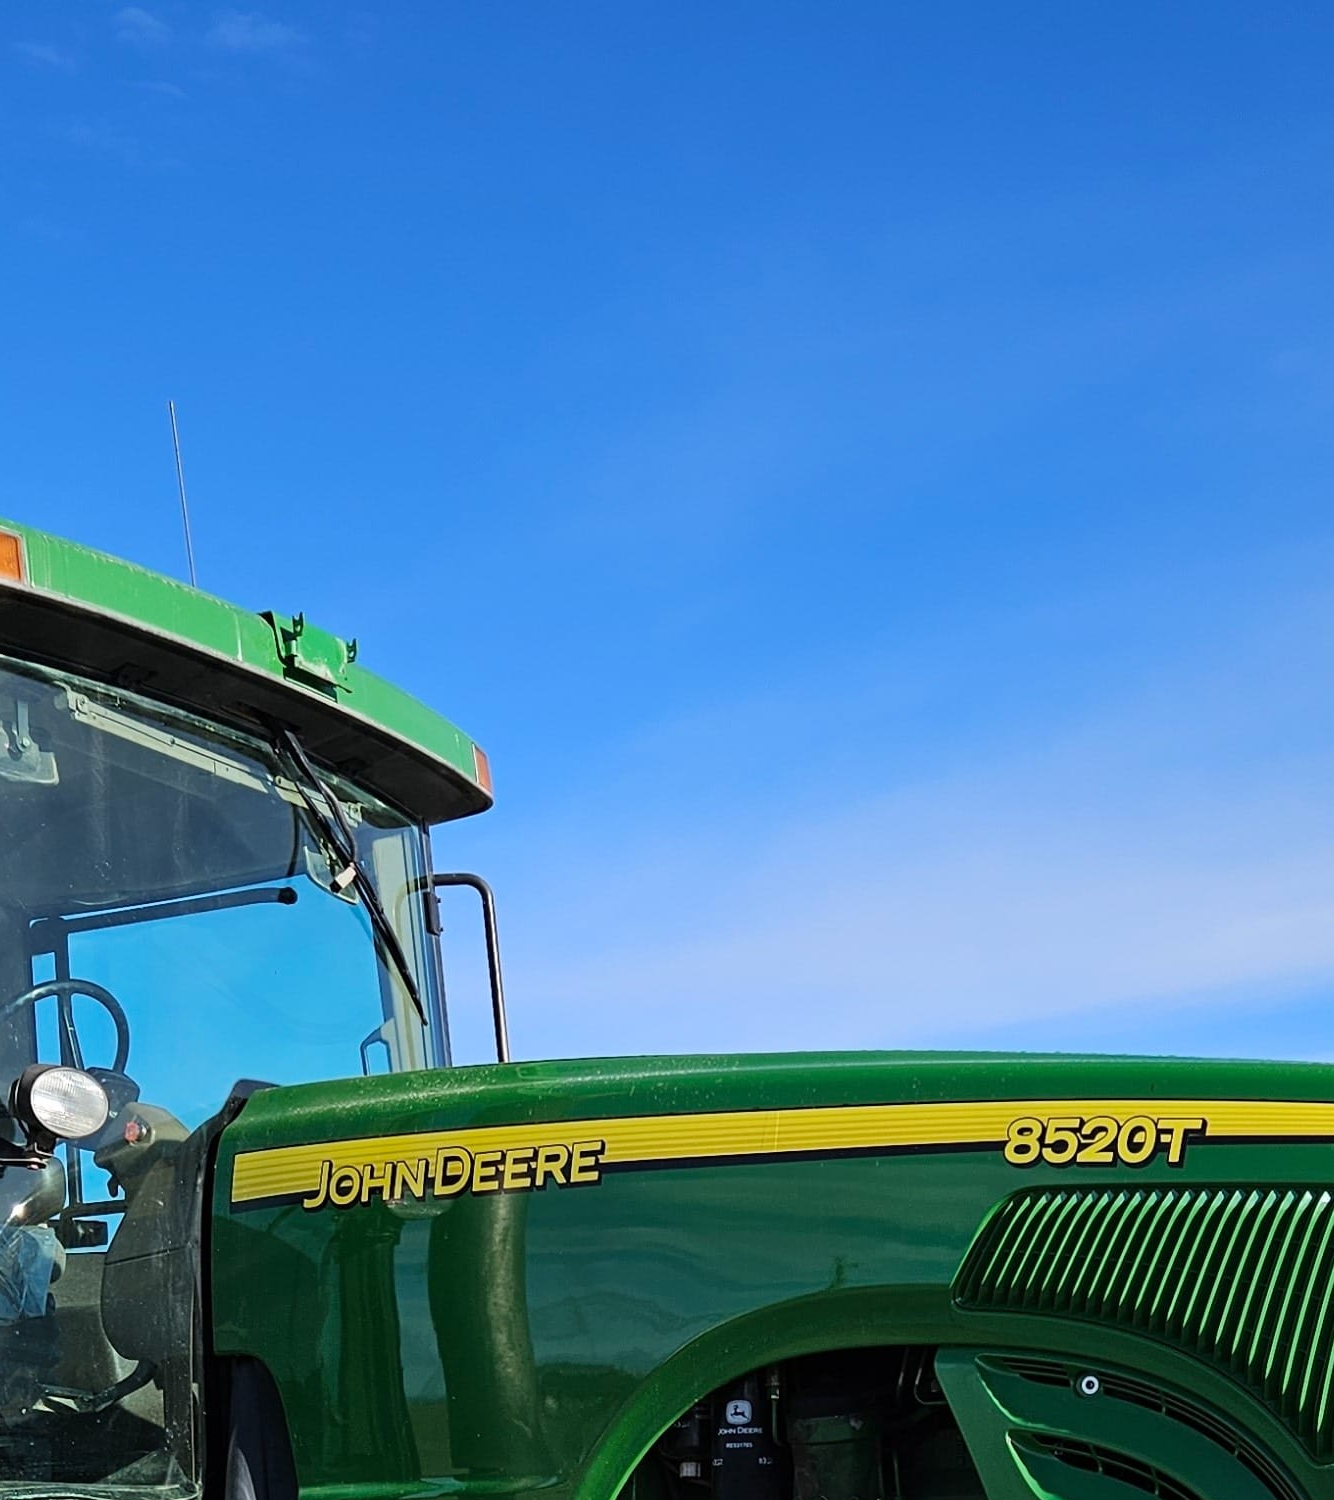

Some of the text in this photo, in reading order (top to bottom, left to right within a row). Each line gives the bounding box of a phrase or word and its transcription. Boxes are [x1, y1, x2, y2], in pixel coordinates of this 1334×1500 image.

[1003, 1116, 1207, 1167] 8520T
[302, 1138, 607, 1210] JOHN DEERE
